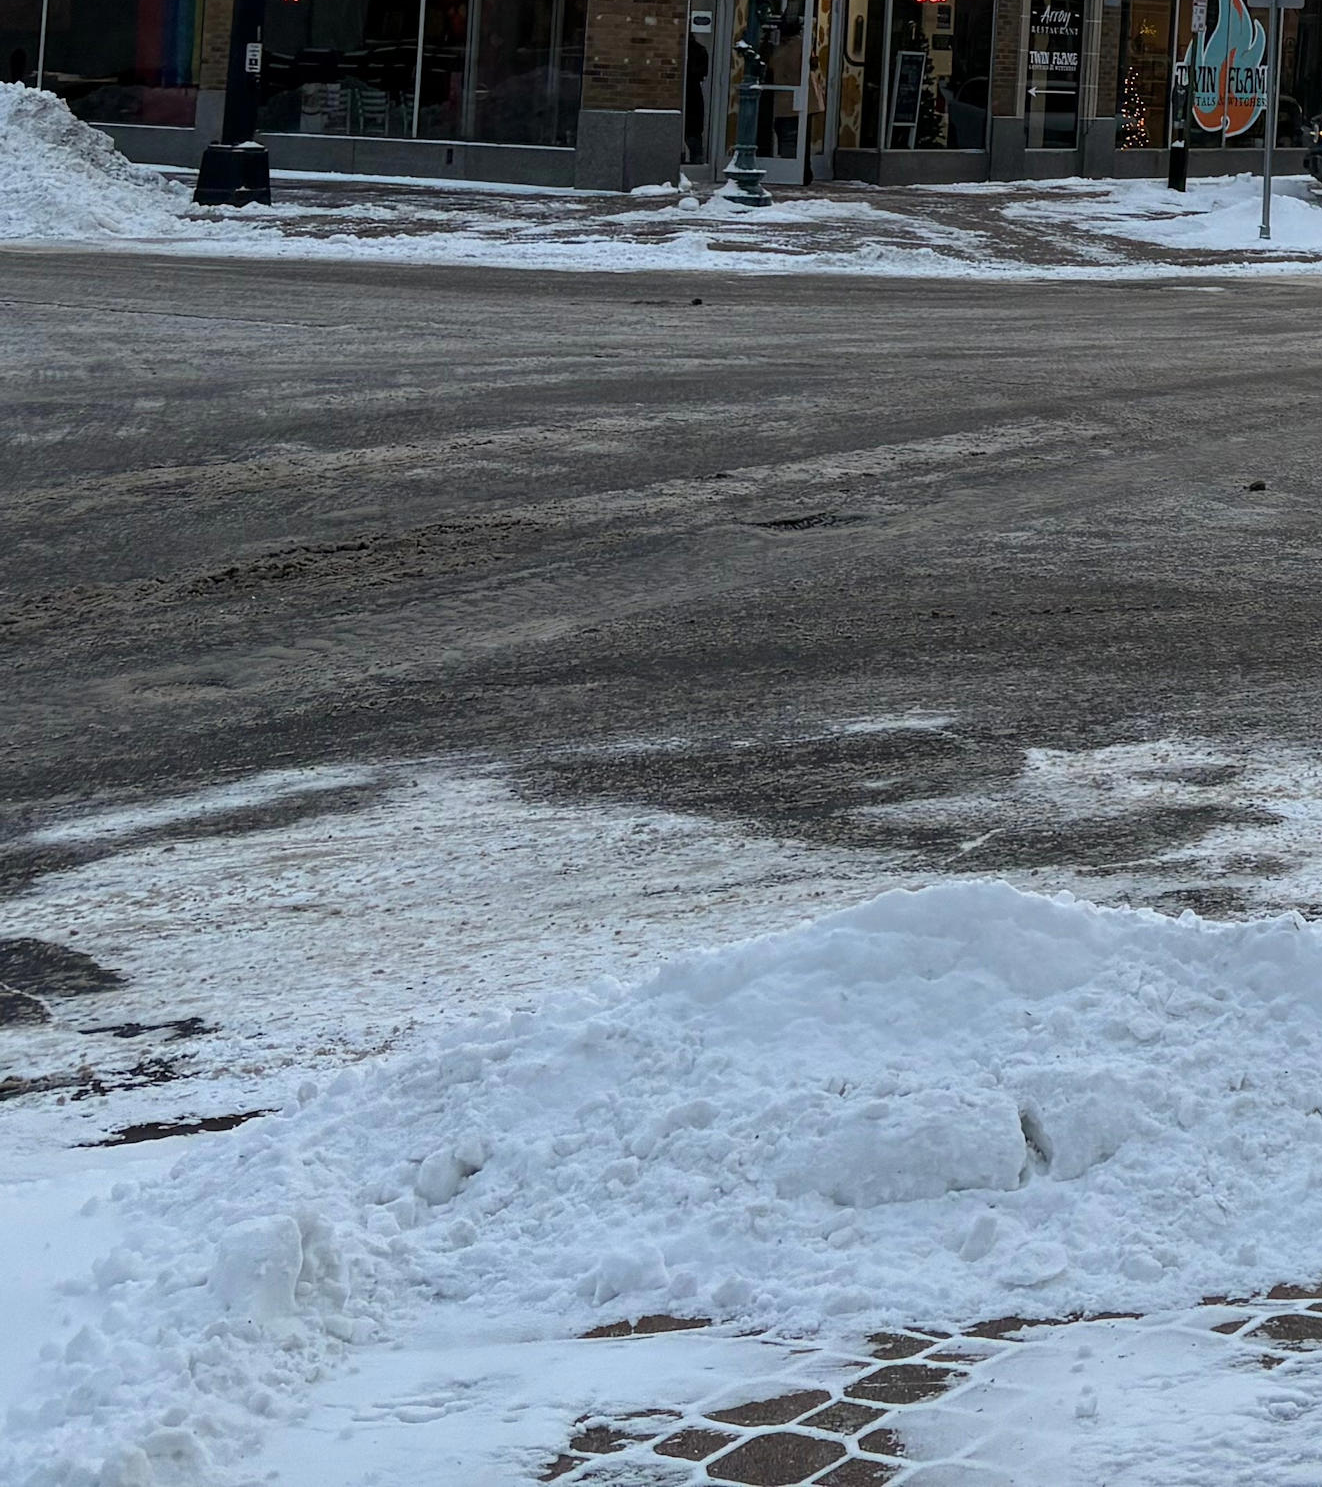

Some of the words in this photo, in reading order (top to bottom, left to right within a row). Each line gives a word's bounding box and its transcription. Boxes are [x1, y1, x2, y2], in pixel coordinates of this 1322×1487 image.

[1031, 25, 1079, 35] RESTAURANT
[1029, 50, 1050, 65] TWIN
[1052, 51, 1079, 67] FLAME
[1228, 67, 1267, 95] FLAM
